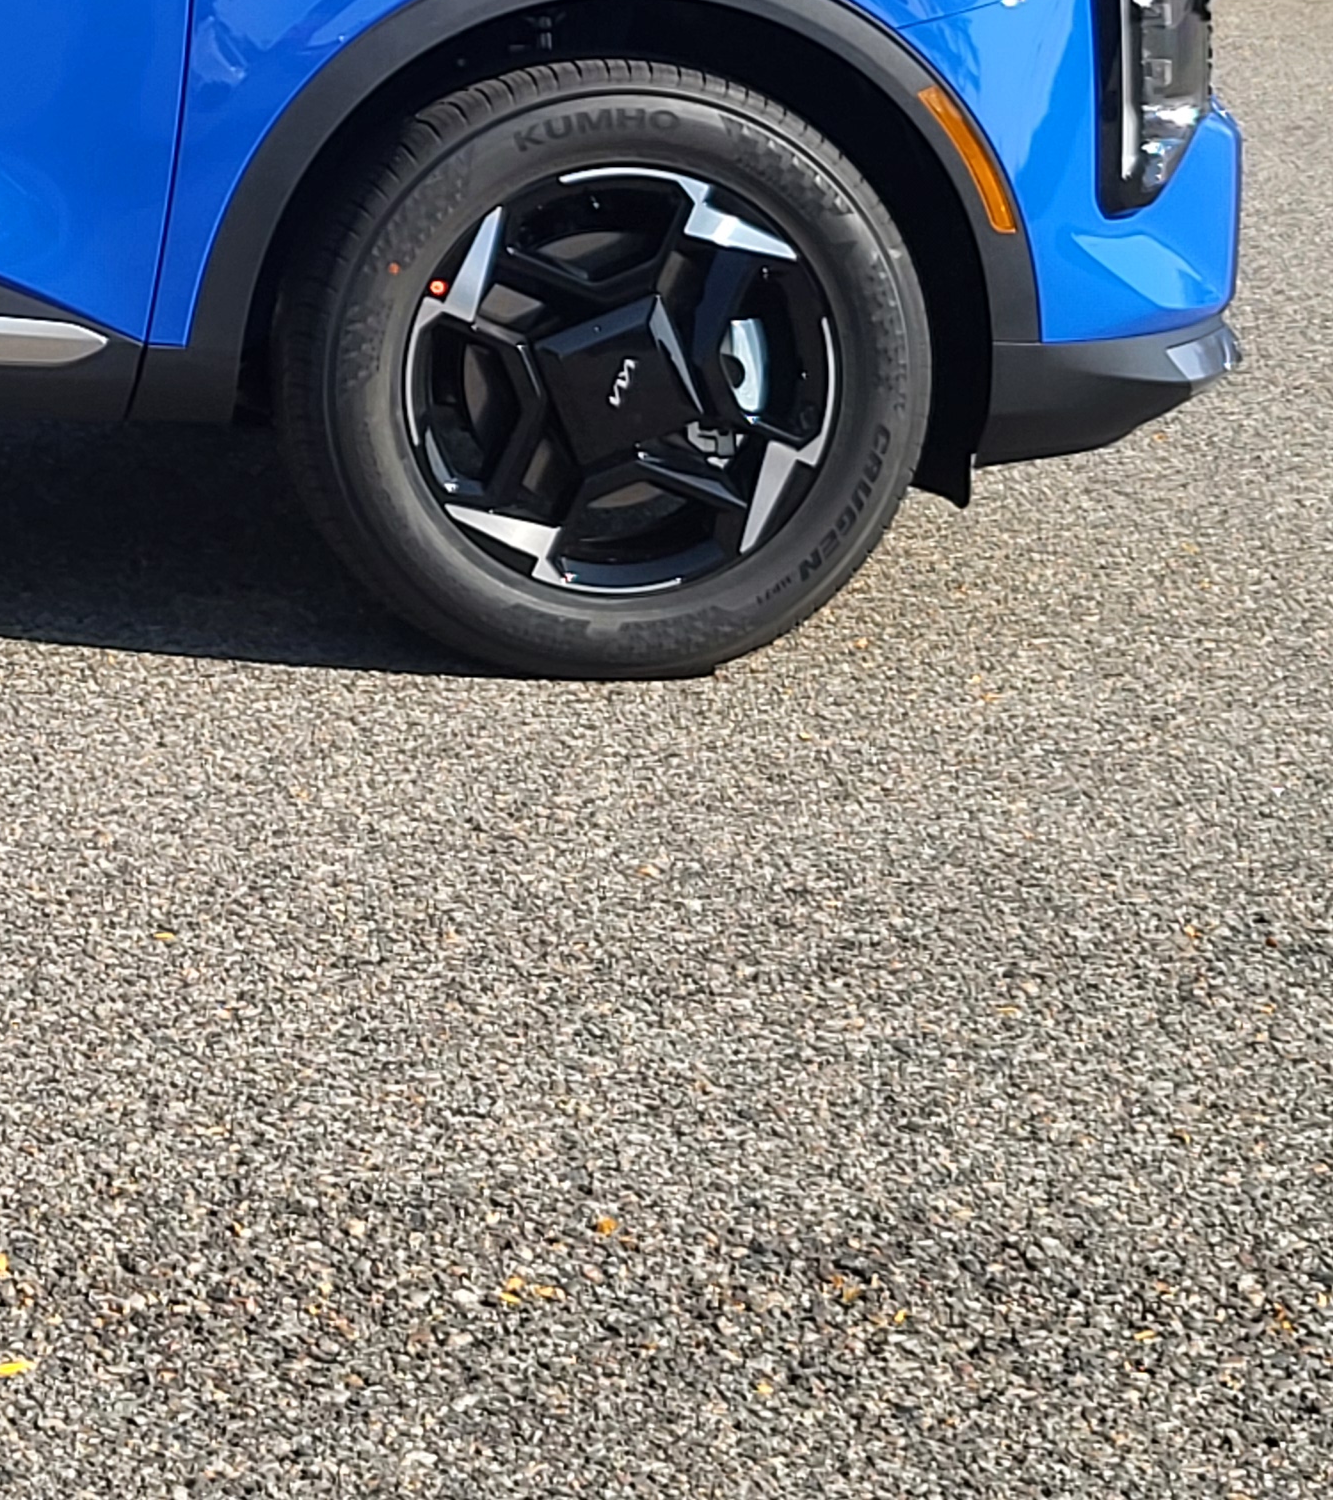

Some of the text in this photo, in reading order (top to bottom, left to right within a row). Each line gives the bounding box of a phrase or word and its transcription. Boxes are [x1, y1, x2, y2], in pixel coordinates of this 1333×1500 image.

[513, 108, 681, 152] KUMHO
[609, 359, 636, 408] KIA
[798, 424, 891, 582] CRUGEN
